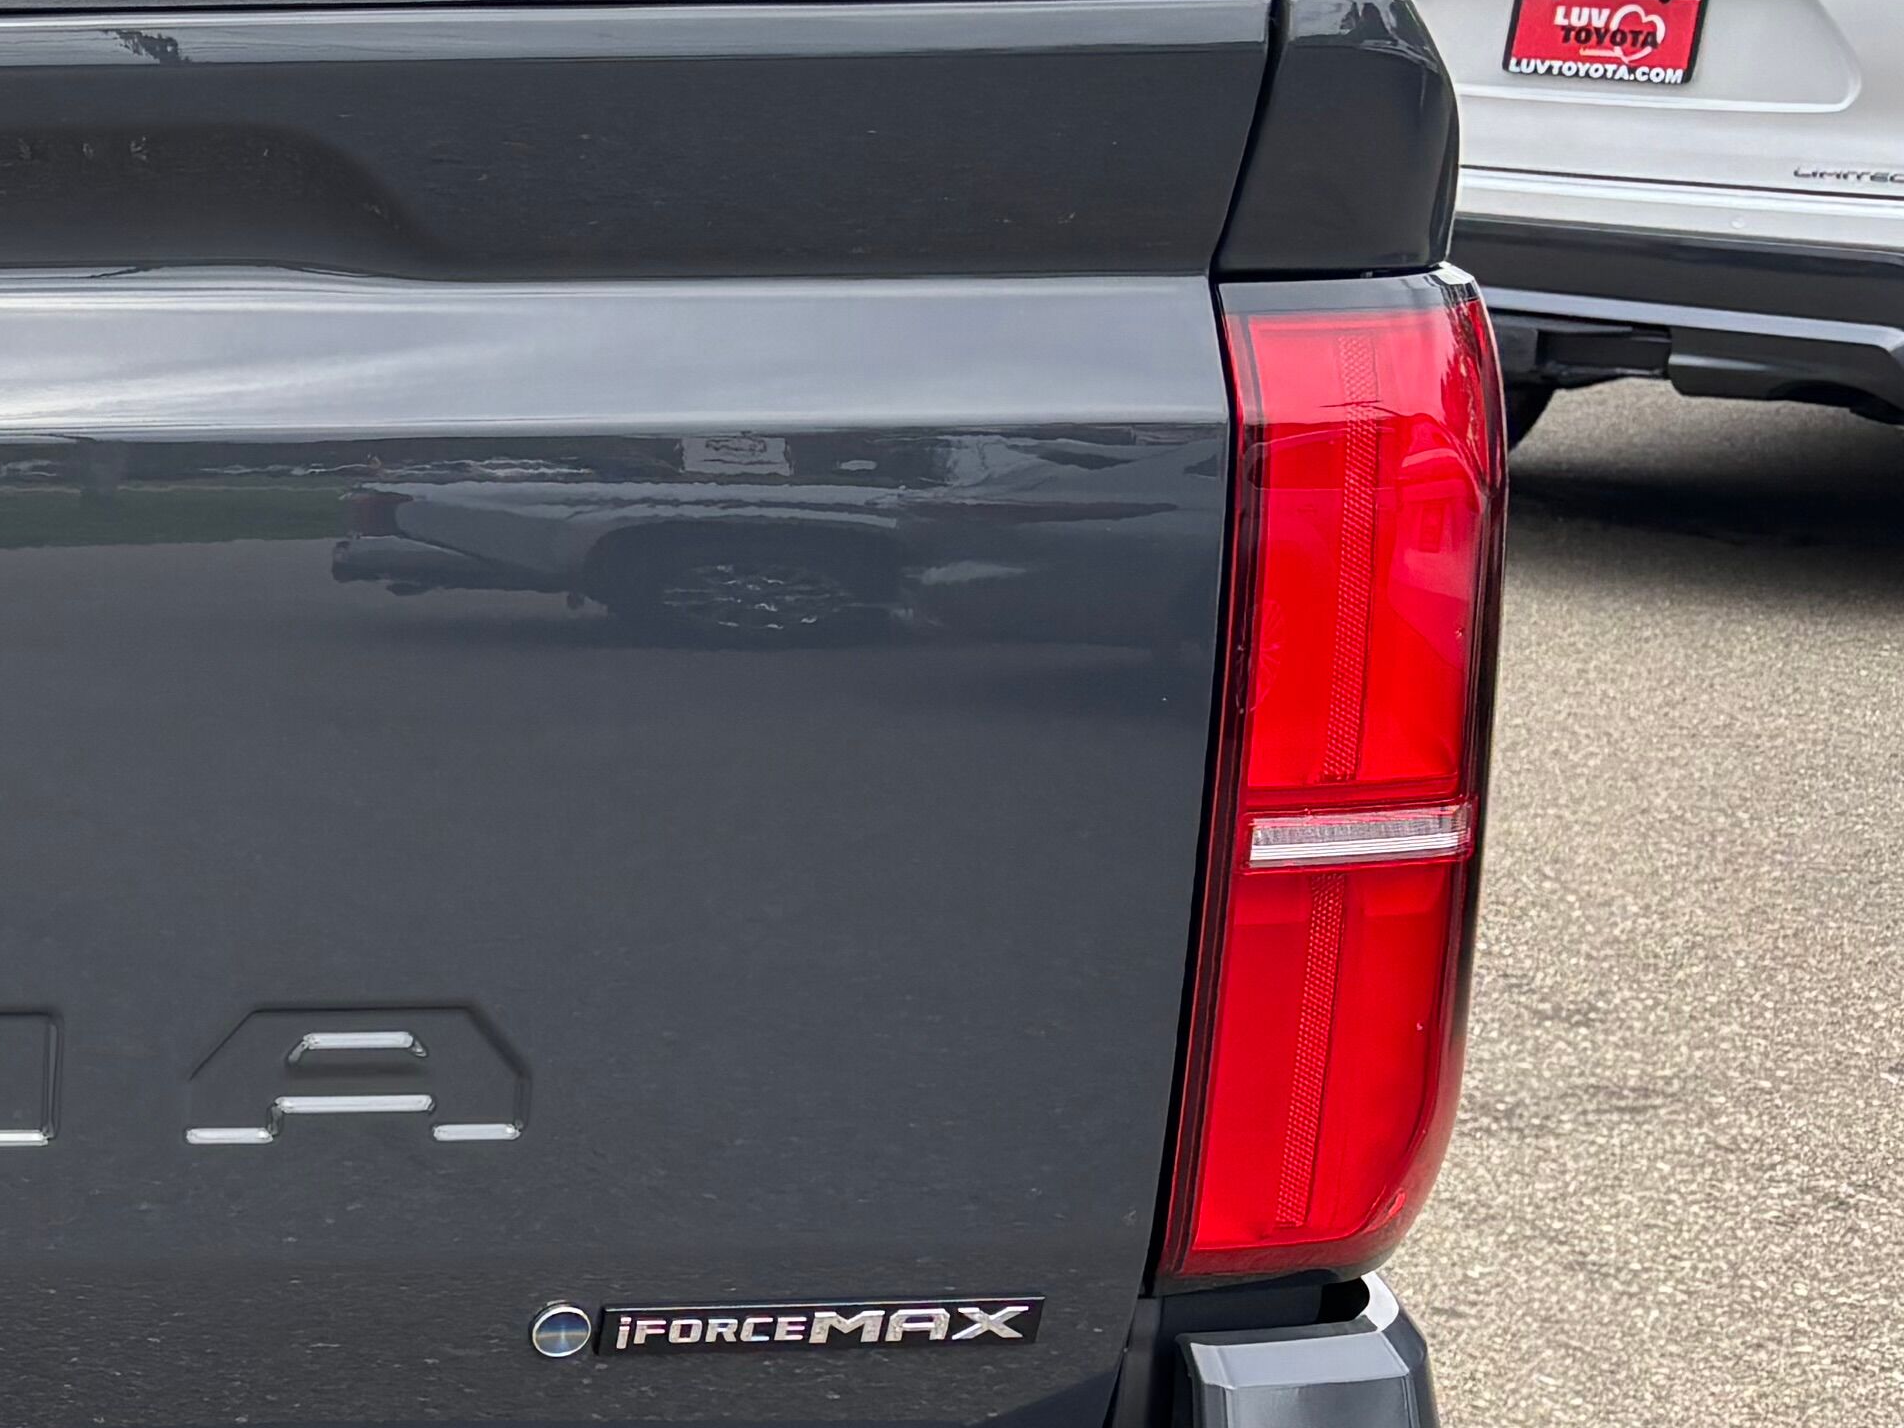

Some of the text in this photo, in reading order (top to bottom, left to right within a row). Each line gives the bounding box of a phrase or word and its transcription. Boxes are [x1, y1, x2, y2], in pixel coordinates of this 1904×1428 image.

[1554, 6, 1611, 27] LUV
[1561, 26, 1658, 49] TOYOTA
[1508, 57, 1683, 84] LUVTOYOTA.COM
